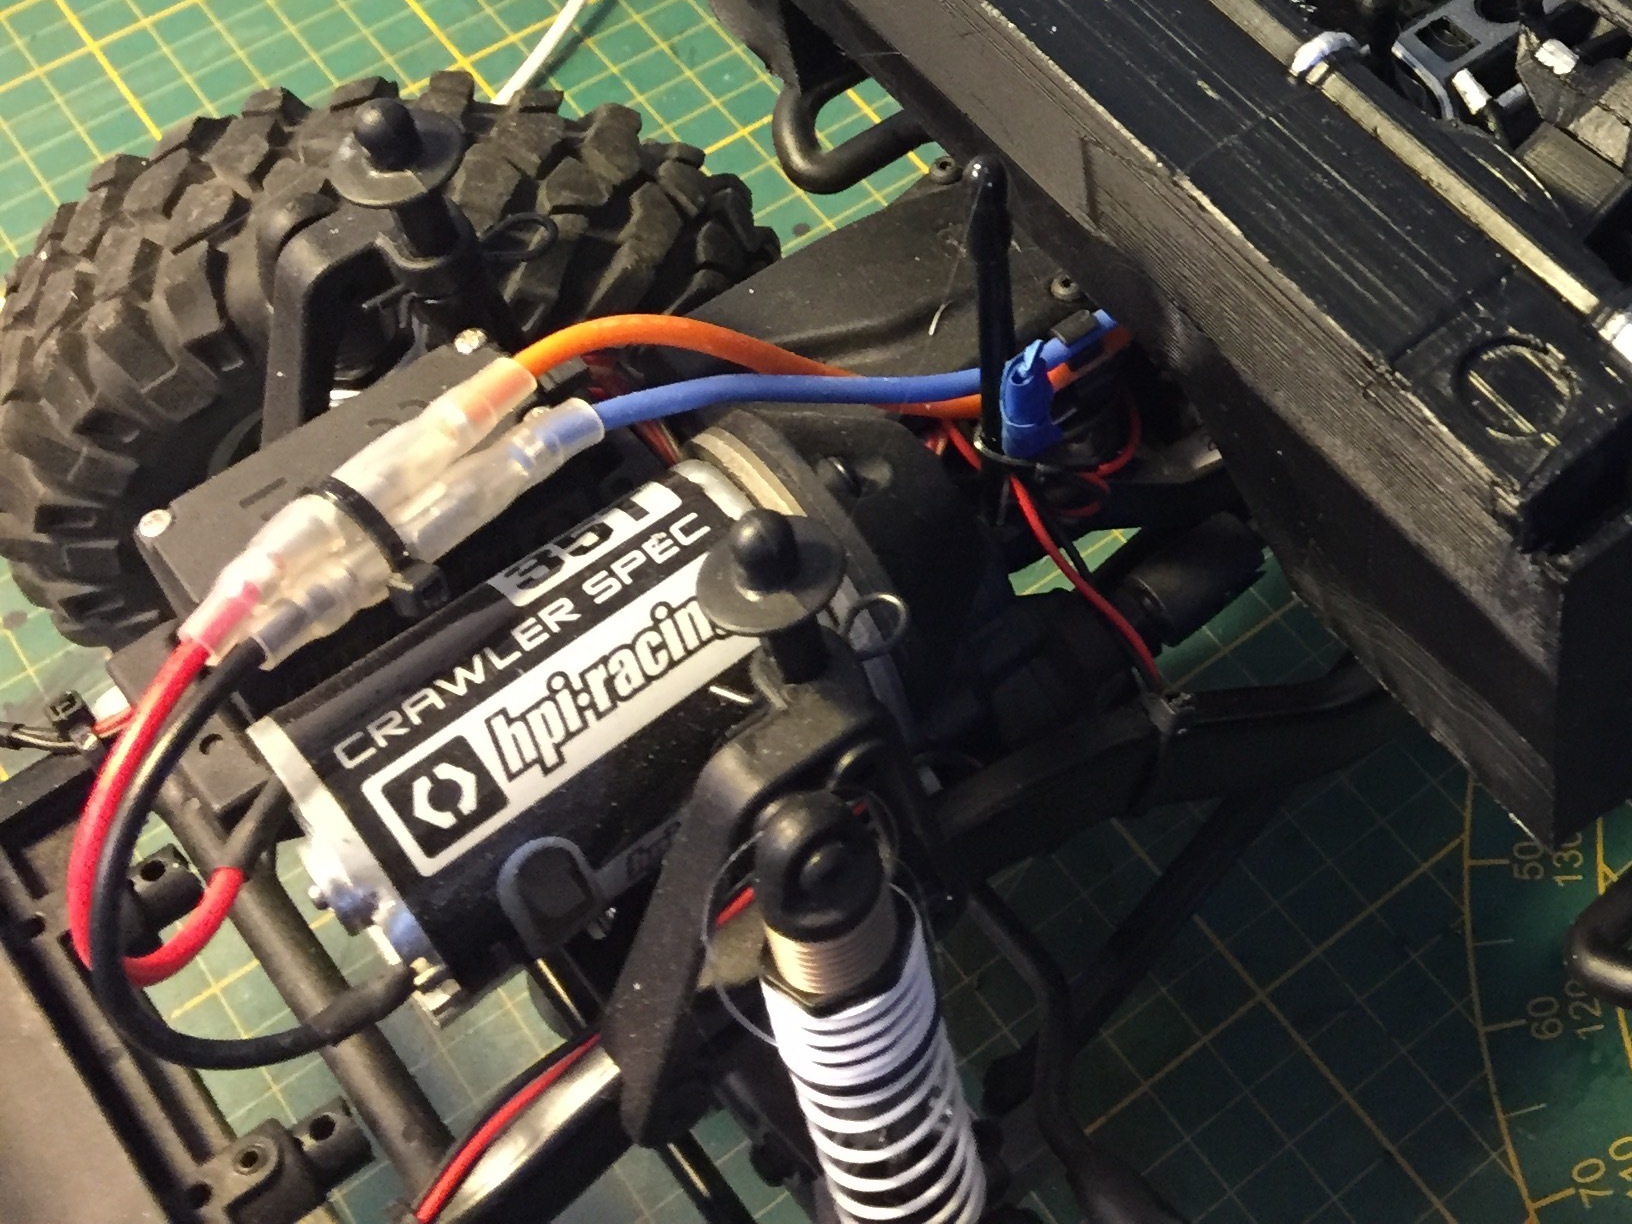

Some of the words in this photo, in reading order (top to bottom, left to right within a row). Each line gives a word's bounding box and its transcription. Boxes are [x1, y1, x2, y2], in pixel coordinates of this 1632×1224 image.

[333, 597, 582, 769] CRAWLER
[581, 512, 711, 605] SPEC
[1513, 841, 1544, 880] 50
[1527, 996, 1563, 1040] 60
[1572, 1158, 1614, 1209] 70
